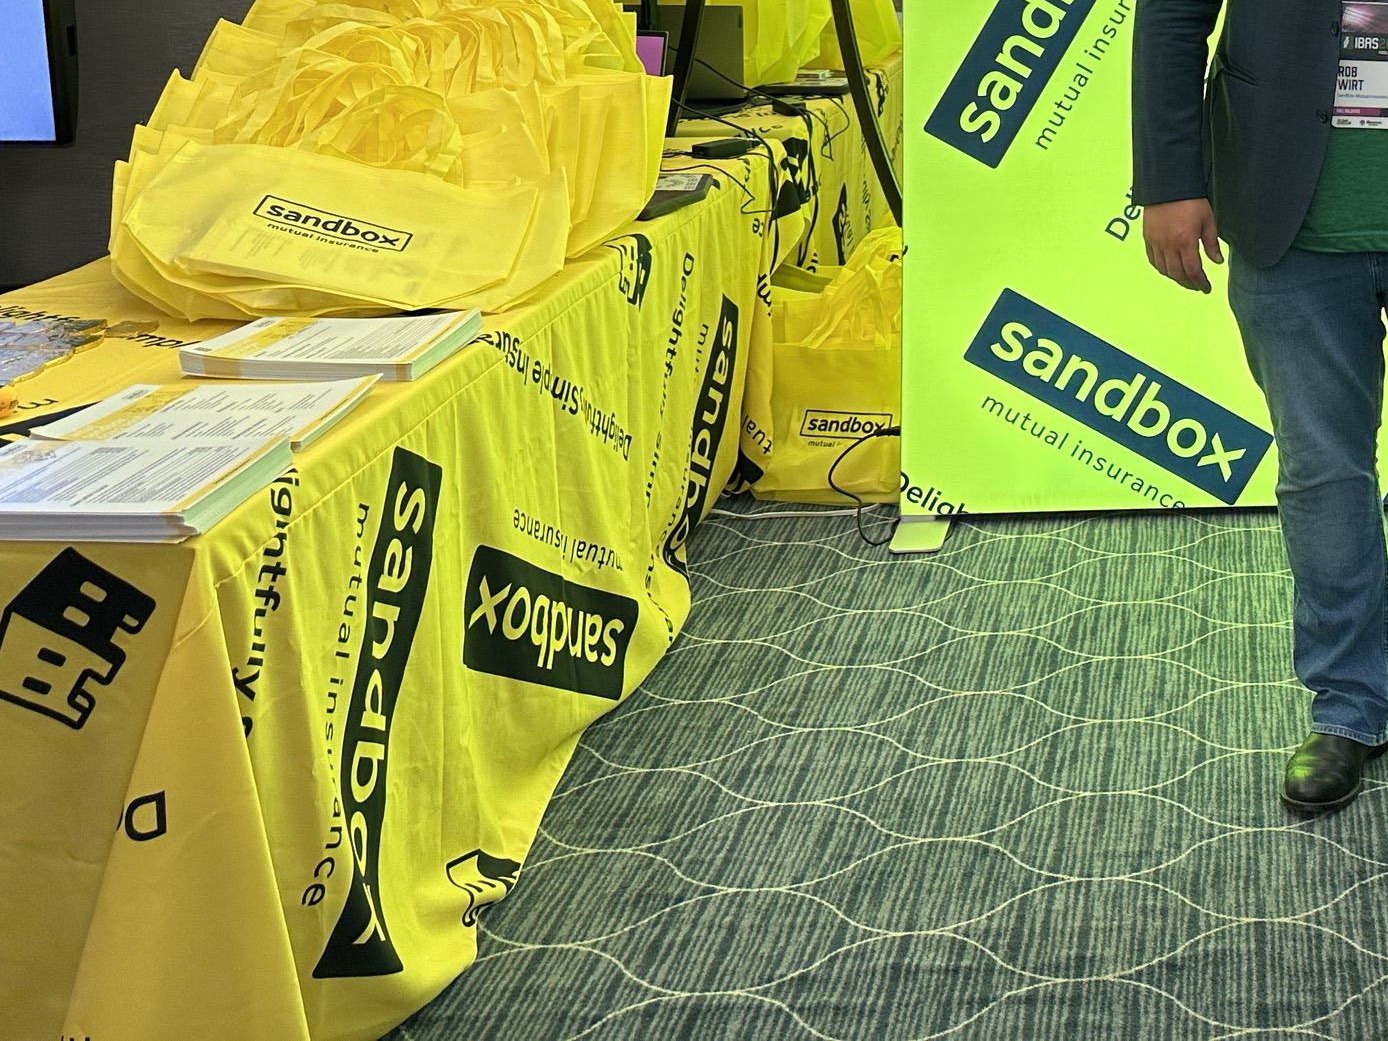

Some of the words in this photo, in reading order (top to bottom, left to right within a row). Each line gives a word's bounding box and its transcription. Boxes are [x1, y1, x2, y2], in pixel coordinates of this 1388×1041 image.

[1035, 65, 1093, 151] mutual
[1338, 66, 1358, 78] ROB
[1338, 80, 1364, 91] WIRT
[266, 203, 400, 247] sandbox
[267, 222, 314, 239] mutual
[316, 234, 380, 253] insurance
[667, 314, 733, 565] sandbo
[990, 319, 1247, 482] sandbox
[981, 394, 1069, 451] mutual
[1071, 439, 1186, 508] insurance
[334, 502, 371, 659] mutual
[468, 575, 625, 670] sandbox
[351, 480, 427, 945] sandbox
